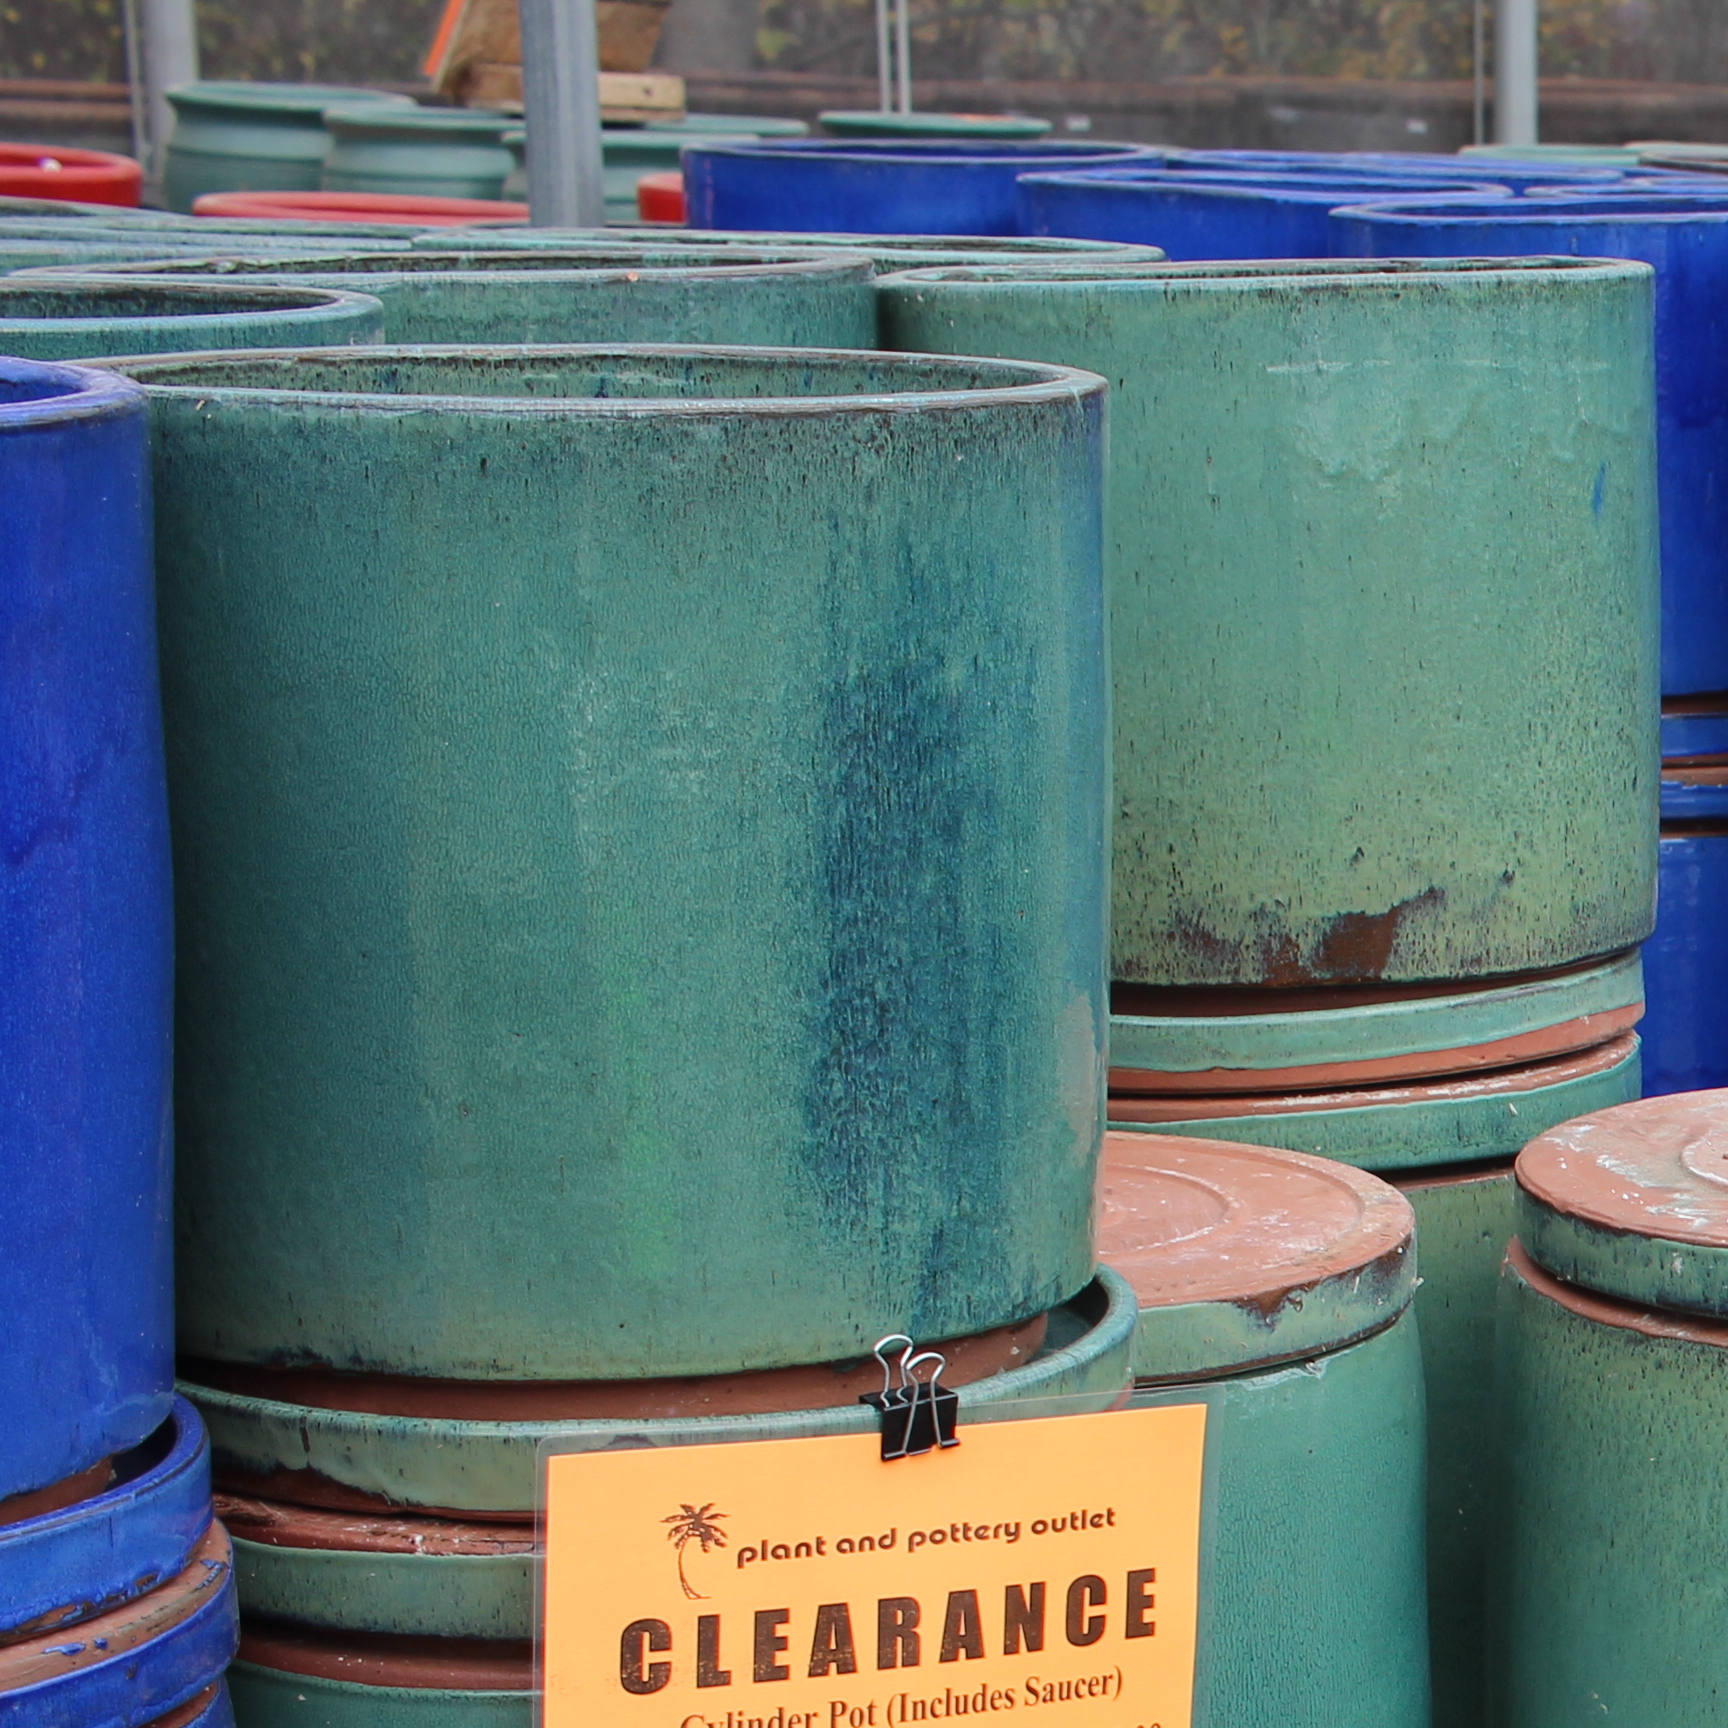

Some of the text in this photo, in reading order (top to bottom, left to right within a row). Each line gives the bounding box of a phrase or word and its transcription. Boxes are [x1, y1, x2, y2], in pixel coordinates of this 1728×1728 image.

[737, 1507, 1117, 1569] plant and pottery outlet
[620, 1567, 1157, 1695] CLEARANCE
[1022, 1665, 1123, 1707] Saucer)
